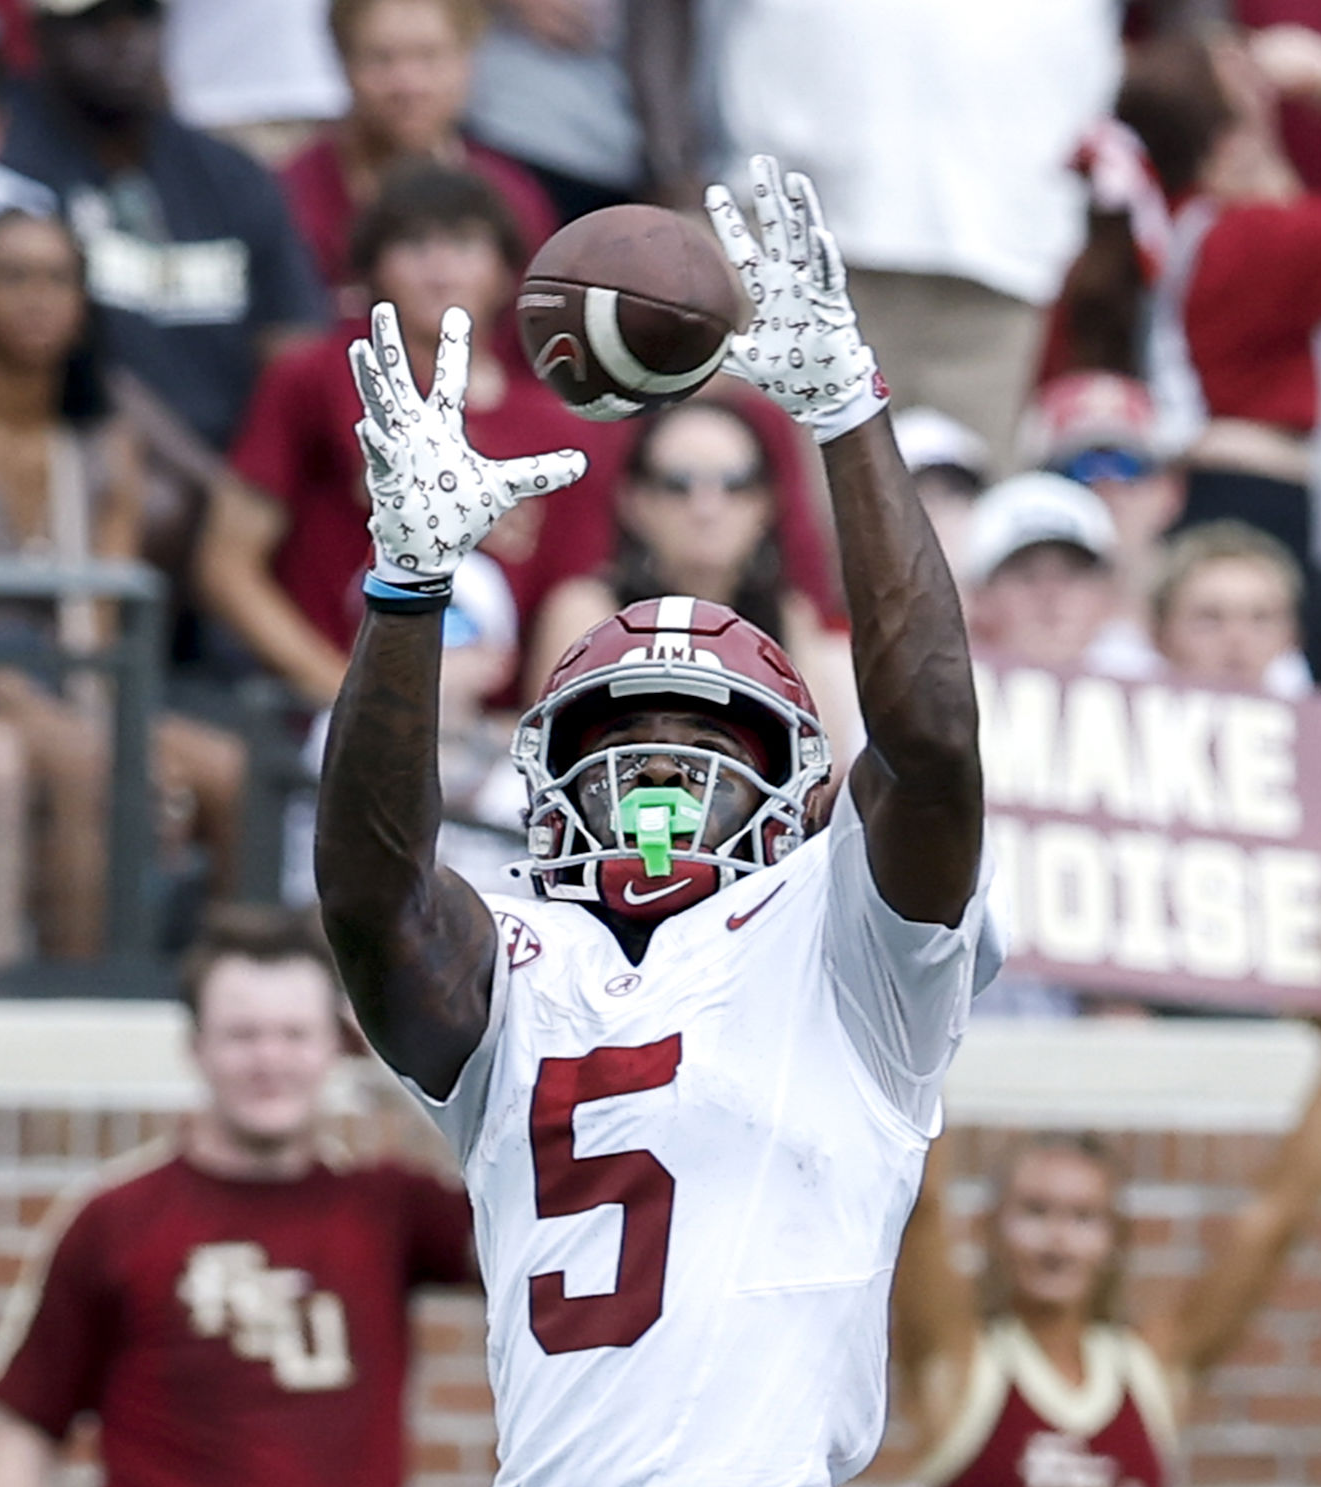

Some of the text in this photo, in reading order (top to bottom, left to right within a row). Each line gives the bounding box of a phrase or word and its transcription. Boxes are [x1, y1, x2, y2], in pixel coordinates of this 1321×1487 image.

[973, 658, 1305, 840] MAKE
[528, 1032, 683, 1357] 5
[177, 1239, 357, 1393] FSU
